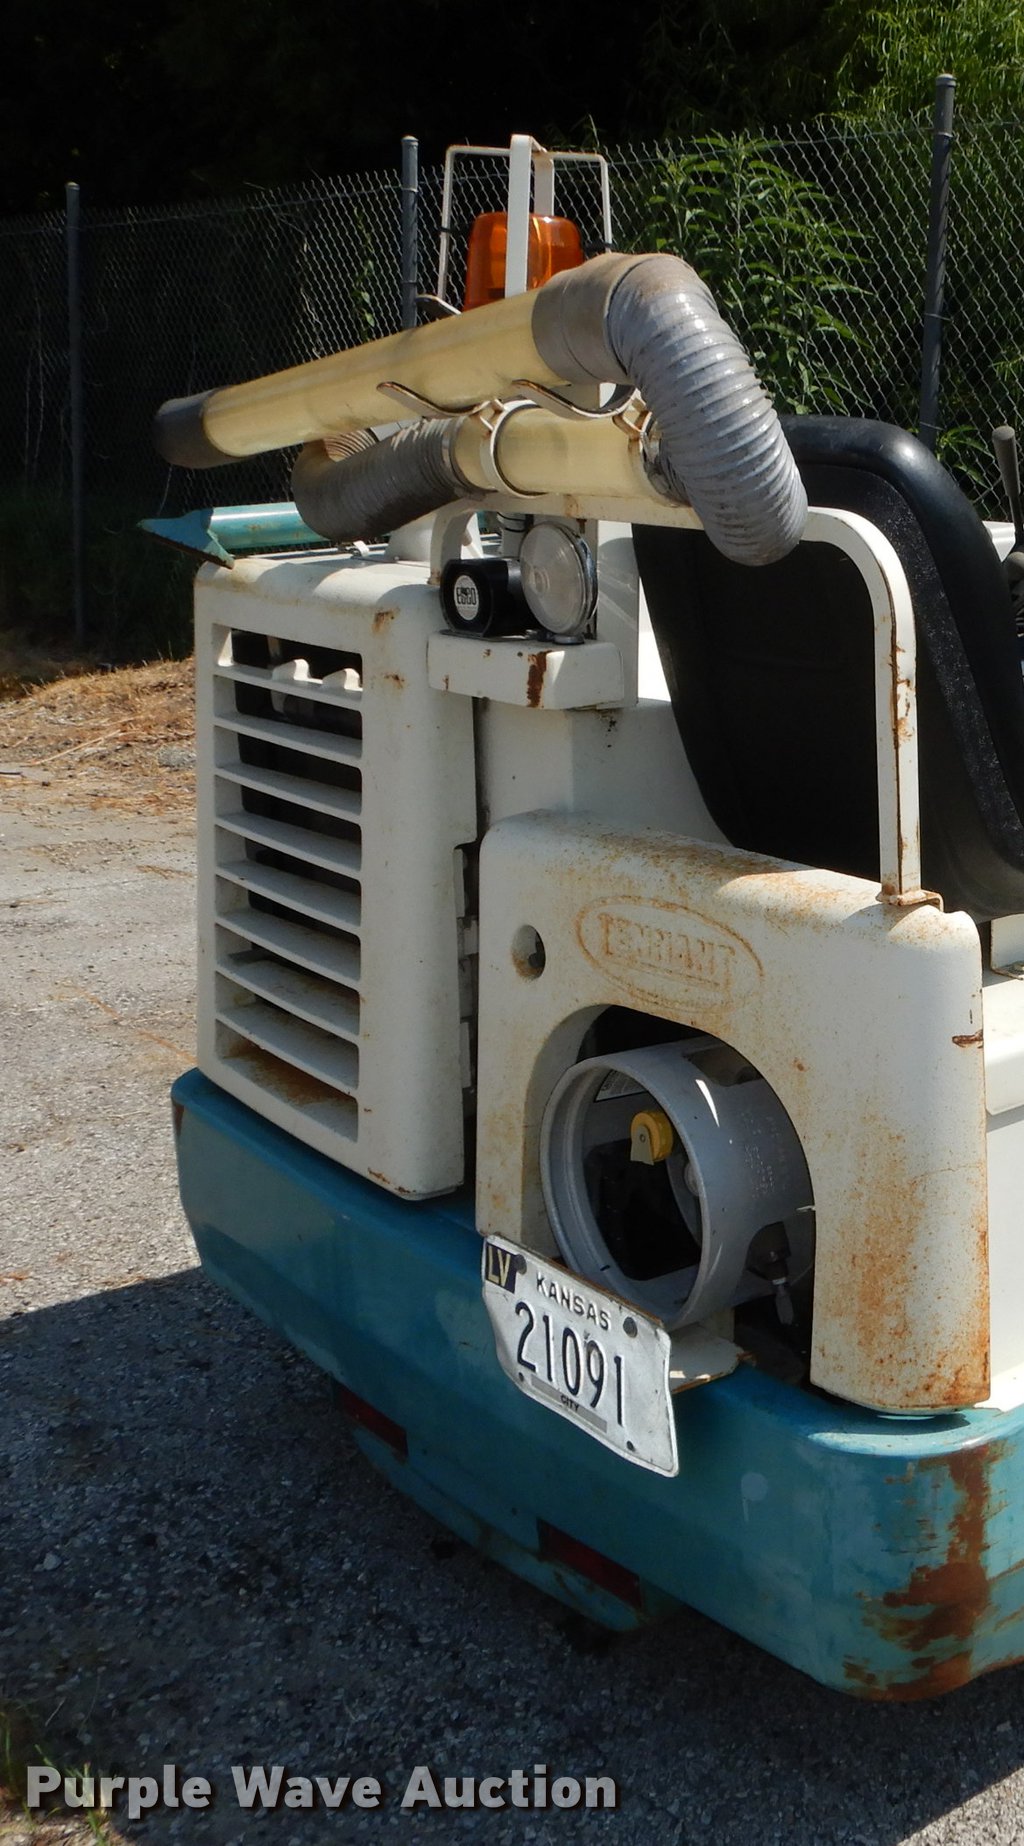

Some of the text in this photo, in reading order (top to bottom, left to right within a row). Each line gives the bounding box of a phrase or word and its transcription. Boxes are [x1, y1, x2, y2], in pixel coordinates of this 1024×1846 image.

[488, 1245, 512, 1285] LV
[536, 1273, 611, 1331] KANSAS
[515, 1301, 624, 1427] 21091
[560, 1394, 580, 1412] CITY
